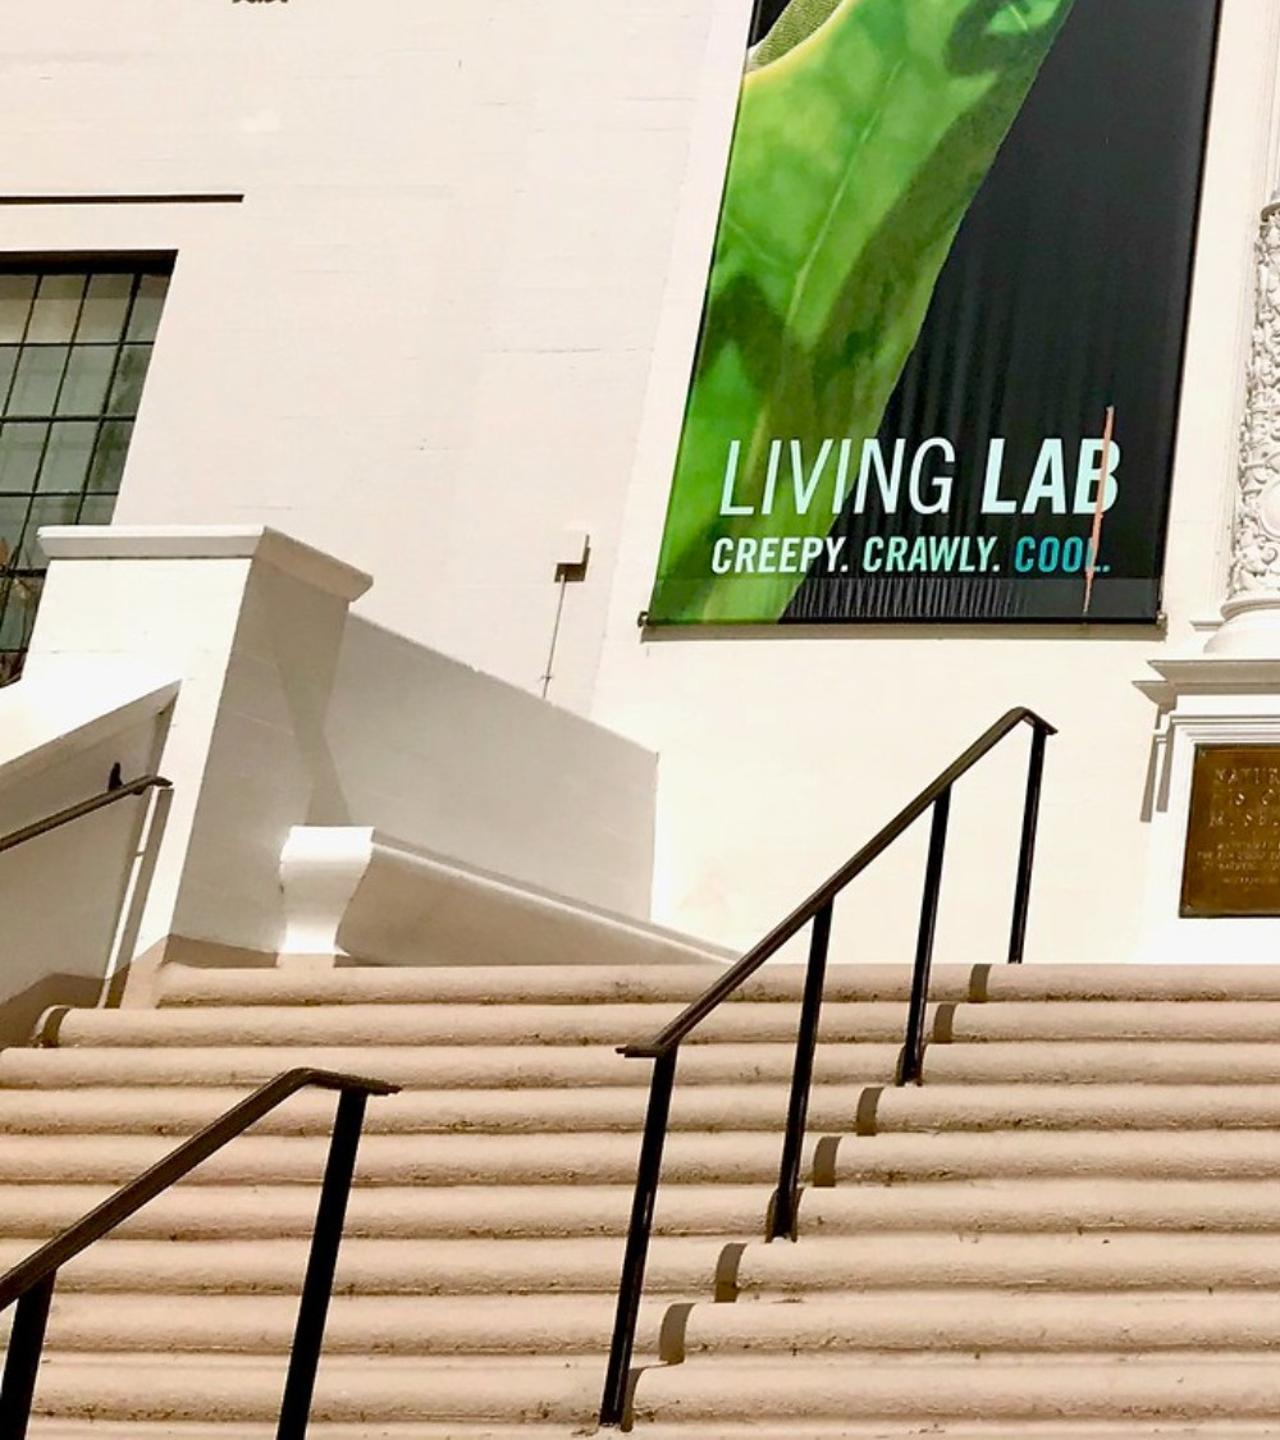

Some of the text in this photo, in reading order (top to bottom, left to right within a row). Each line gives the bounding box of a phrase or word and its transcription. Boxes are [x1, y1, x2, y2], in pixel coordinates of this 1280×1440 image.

[718, 436, 1121, 516] LIVING LAB
[711, 535, 849, 575] CREEPY.
[862, 535, 1001, 574] CRAWLY.
